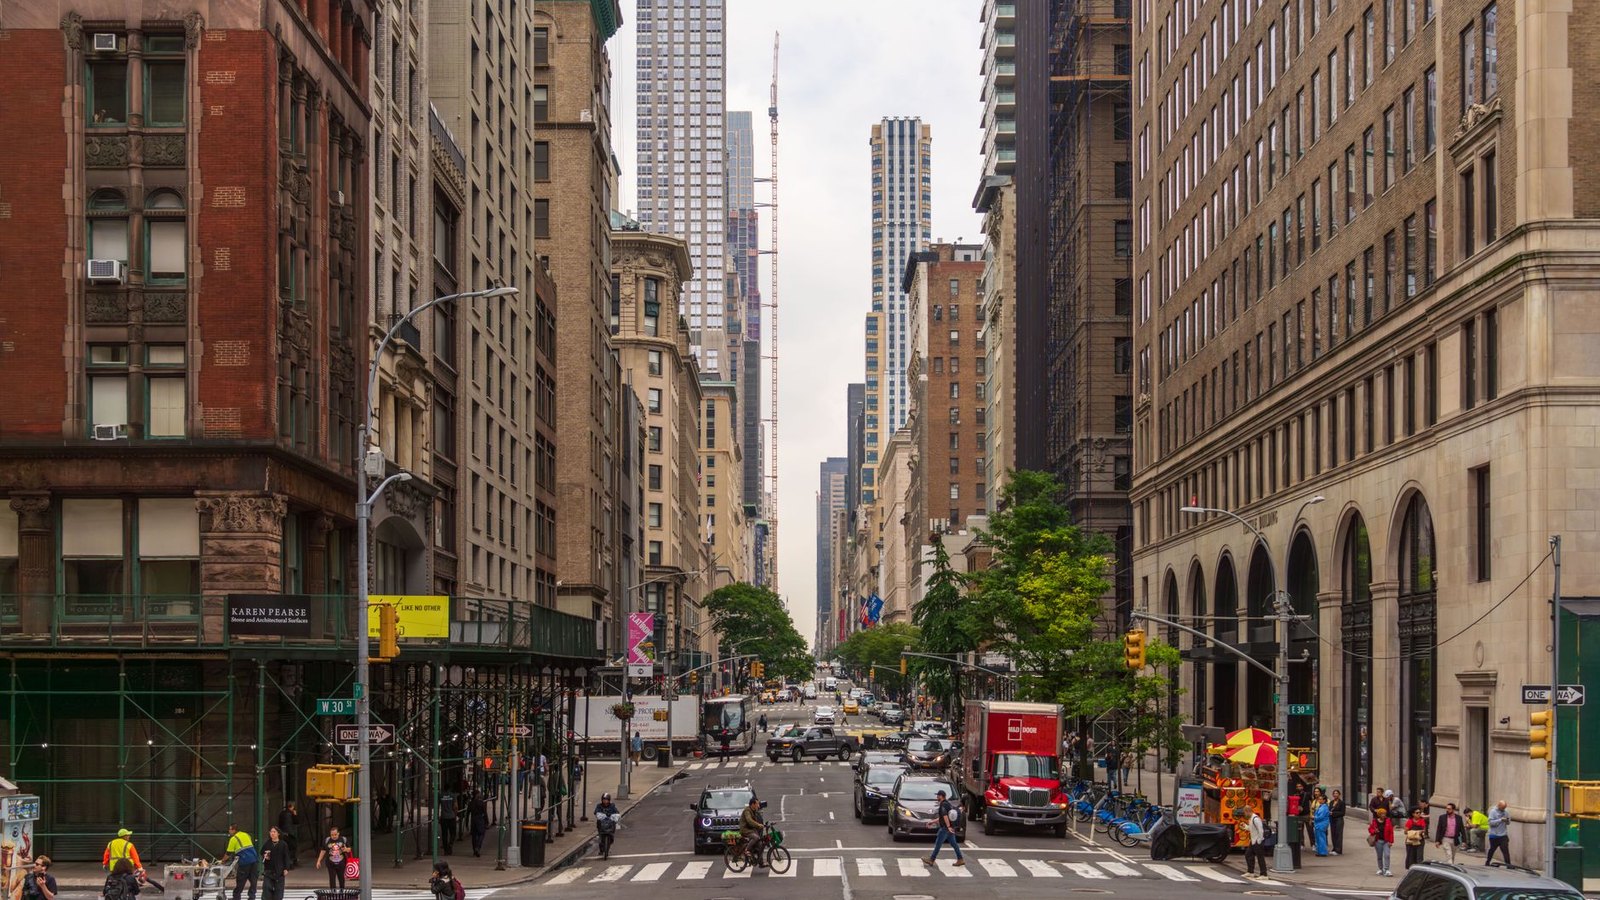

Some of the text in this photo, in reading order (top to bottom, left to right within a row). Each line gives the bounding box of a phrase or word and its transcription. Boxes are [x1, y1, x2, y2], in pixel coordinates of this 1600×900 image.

[231, 608, 307, 617] KAREN PEARSE
[1527, 691, 1576, 699] ONE WAY
[321, 701, 329, 713] W
[332, 701, 344, 713] 30
[1291, 705, 1295, 714] E
[1296, 705, 1305, 714] 30
[342, 730, 384, 739] ONE WAY
